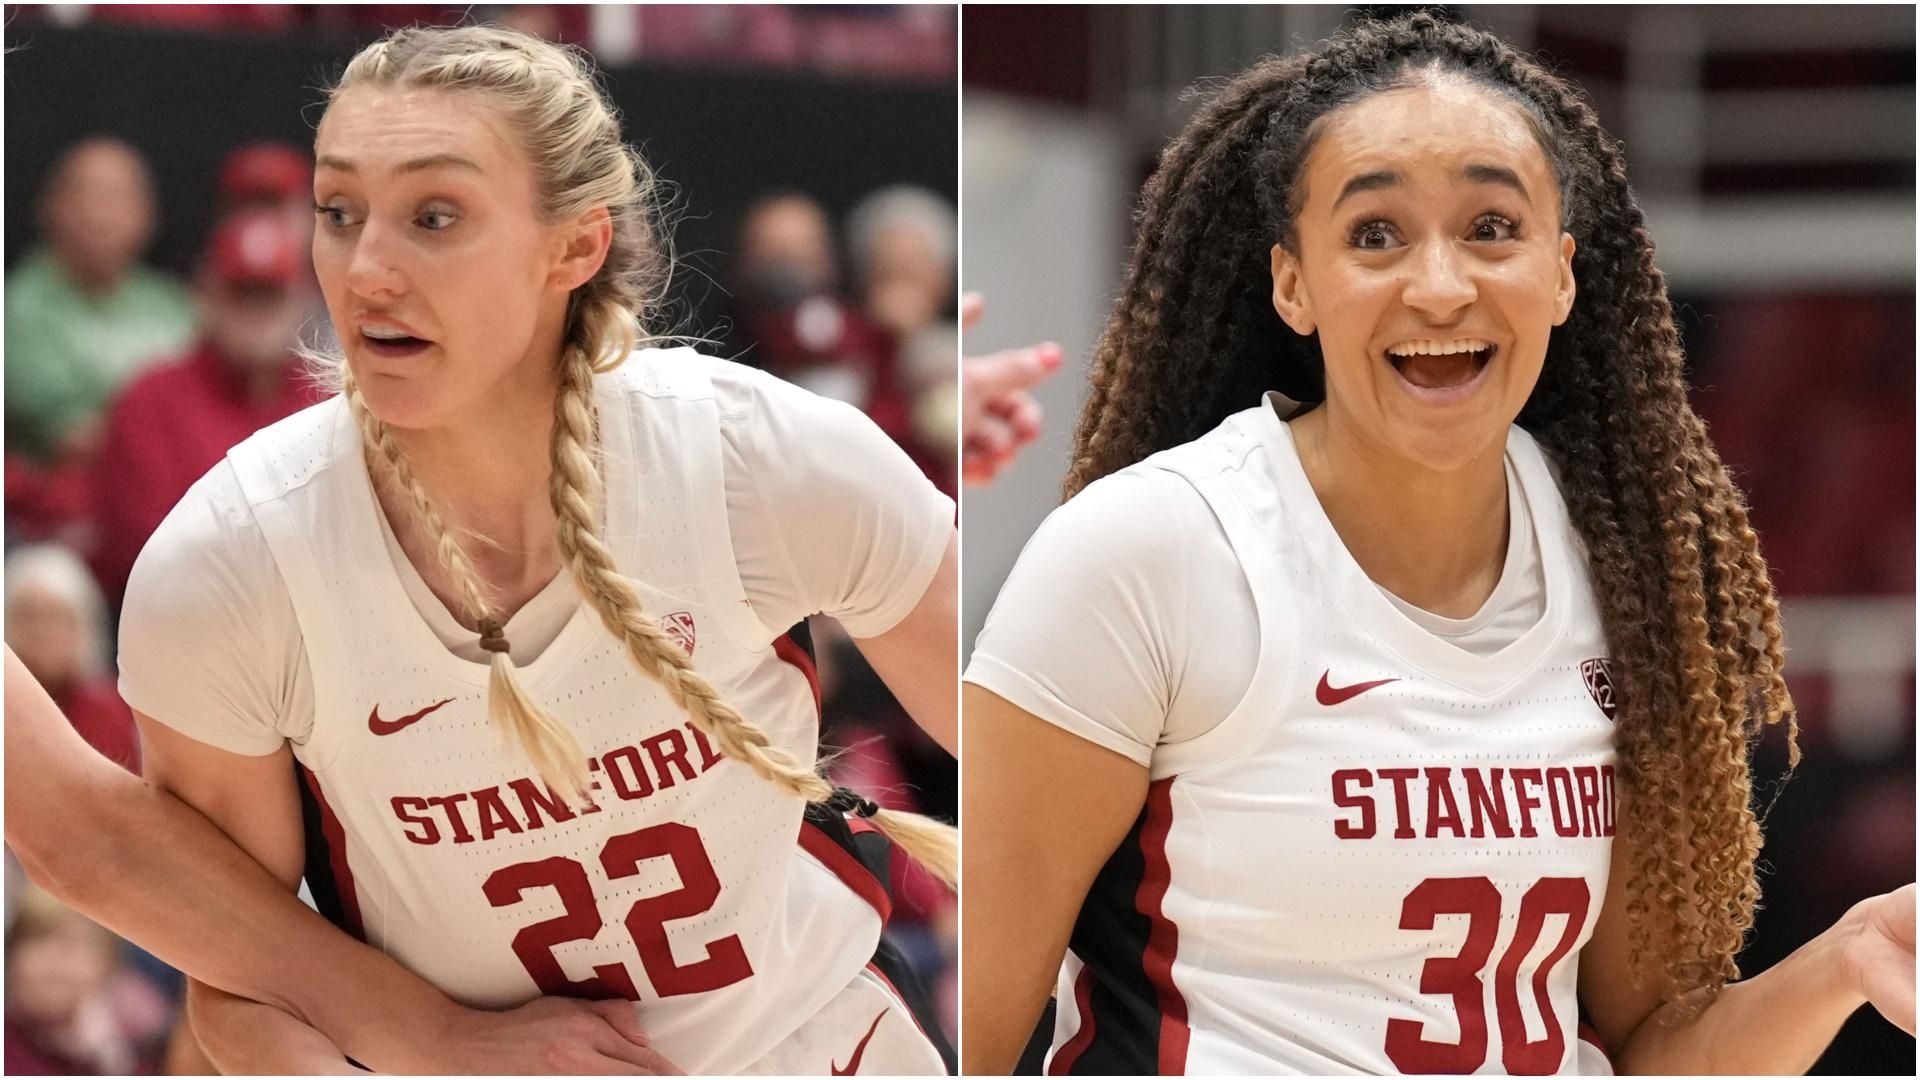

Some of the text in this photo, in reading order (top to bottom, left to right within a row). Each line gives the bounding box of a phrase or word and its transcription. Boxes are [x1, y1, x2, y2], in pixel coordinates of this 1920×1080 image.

[1331, 765, 1616, 839] STANFORD
[481, 821, 755, 1001] 22
[1384, 876, 1591, 1075] 30
